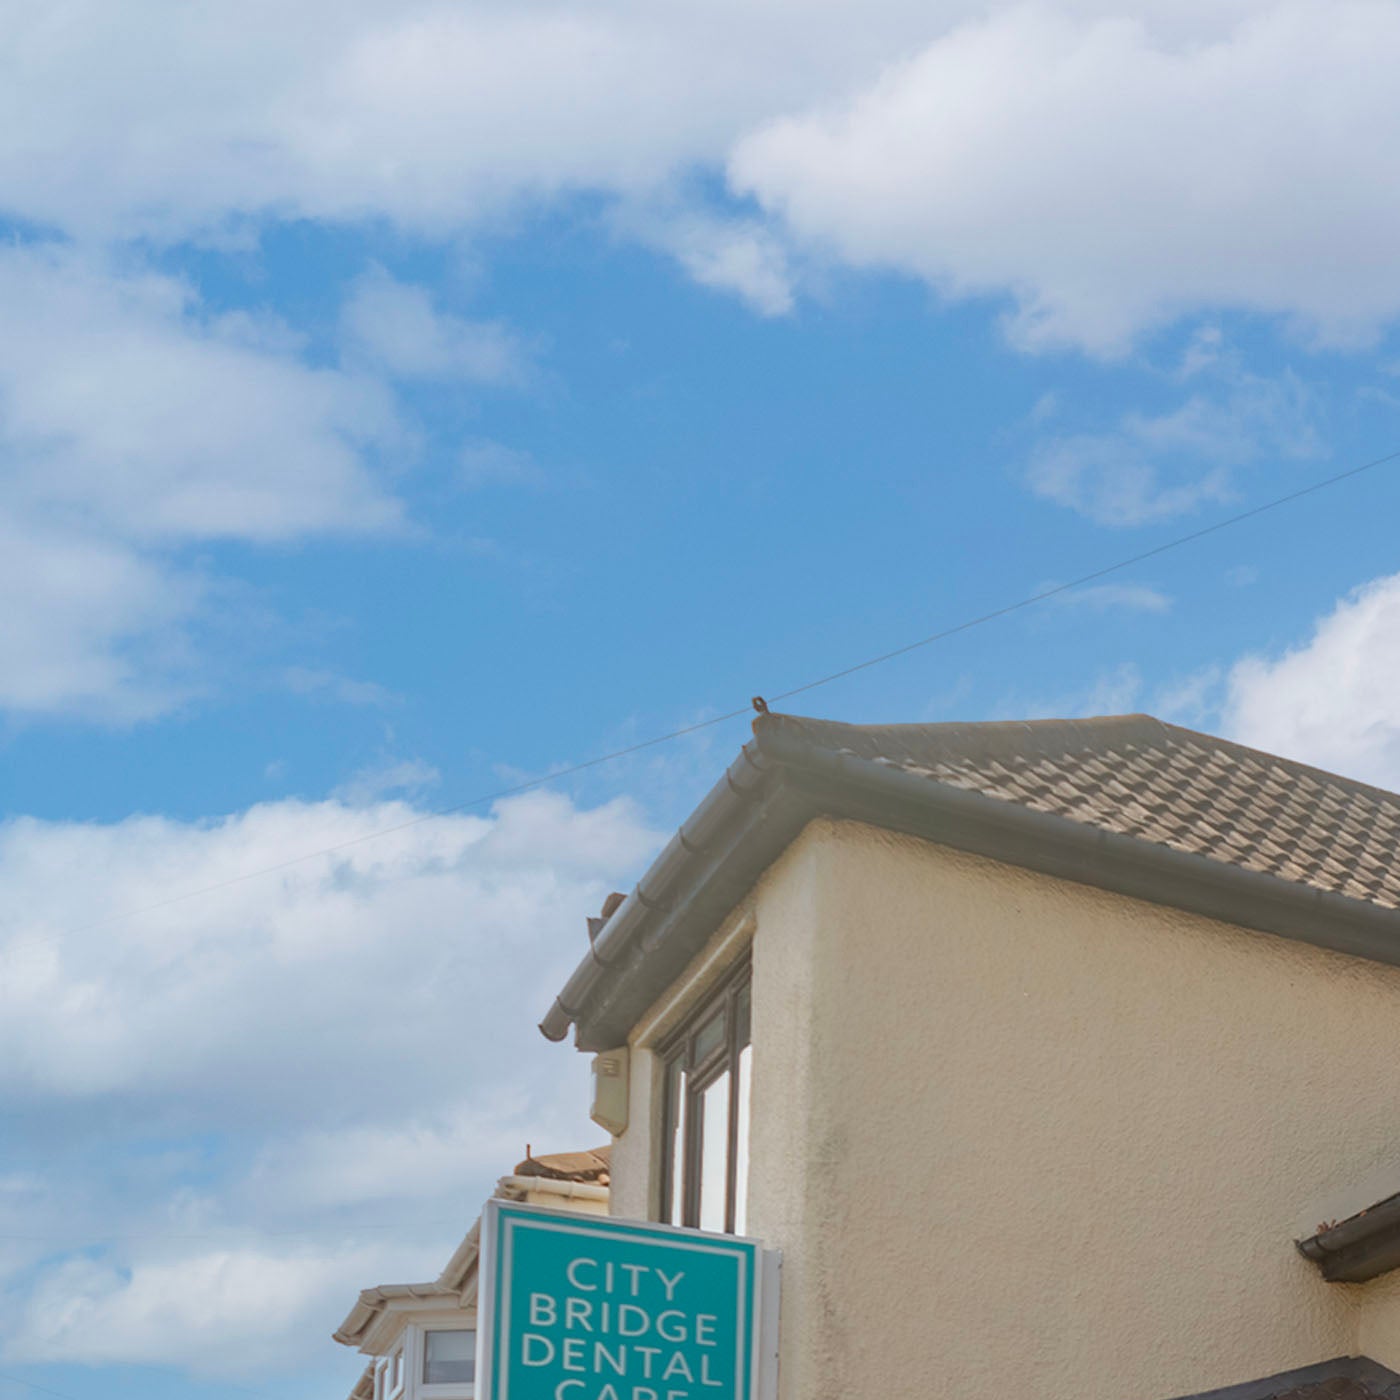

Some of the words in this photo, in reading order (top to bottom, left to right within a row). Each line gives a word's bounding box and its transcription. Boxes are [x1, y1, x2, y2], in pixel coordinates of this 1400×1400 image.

[566, 1257, 686, 1301] CITY
[529, 1292, 718, 1347] BRIDGE
[521, 1333, 724, 1387] DENTAL
